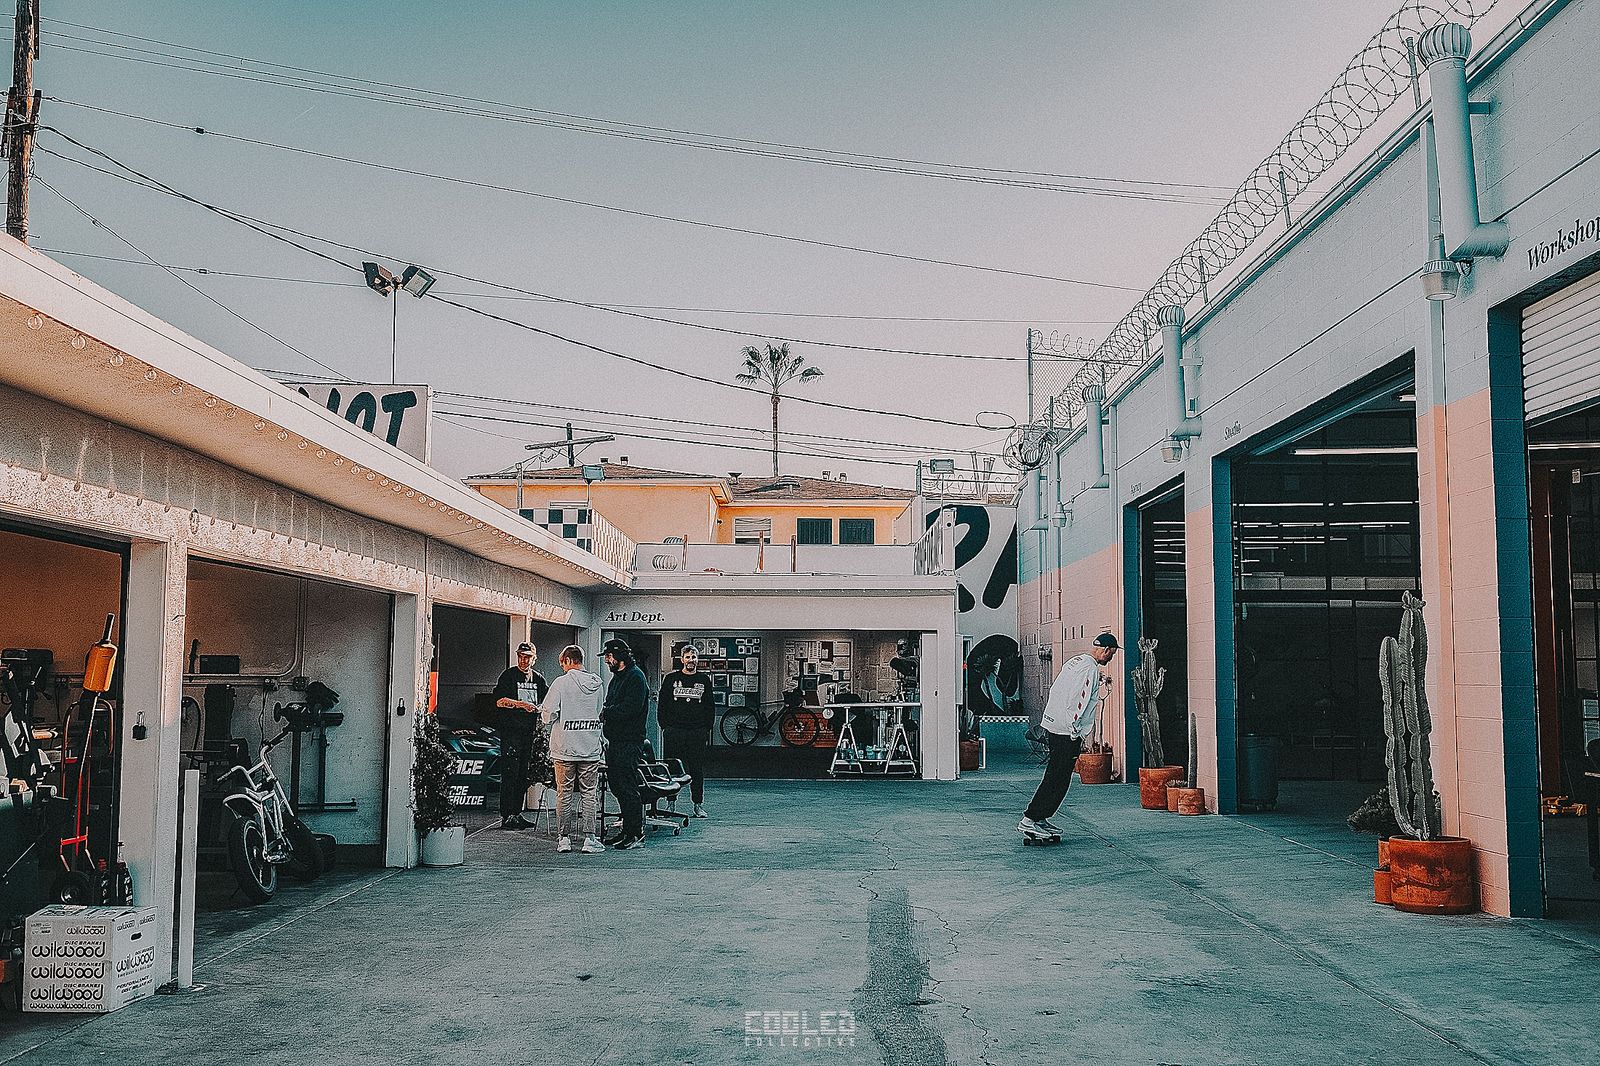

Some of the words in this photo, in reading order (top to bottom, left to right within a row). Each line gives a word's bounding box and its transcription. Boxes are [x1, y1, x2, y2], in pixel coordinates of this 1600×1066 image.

[605, 611, 626, 621] Art
[630, 611, 665, 624] Dept.
[66, 926, 106, 935] wilwood
[32, 941, 105, 957] wilwood
[31, 962, 105, 979] wilwood
[30, 983, 104, 1000] wilwood
[29, 1001, 103, 1010] www.wilwood.com
